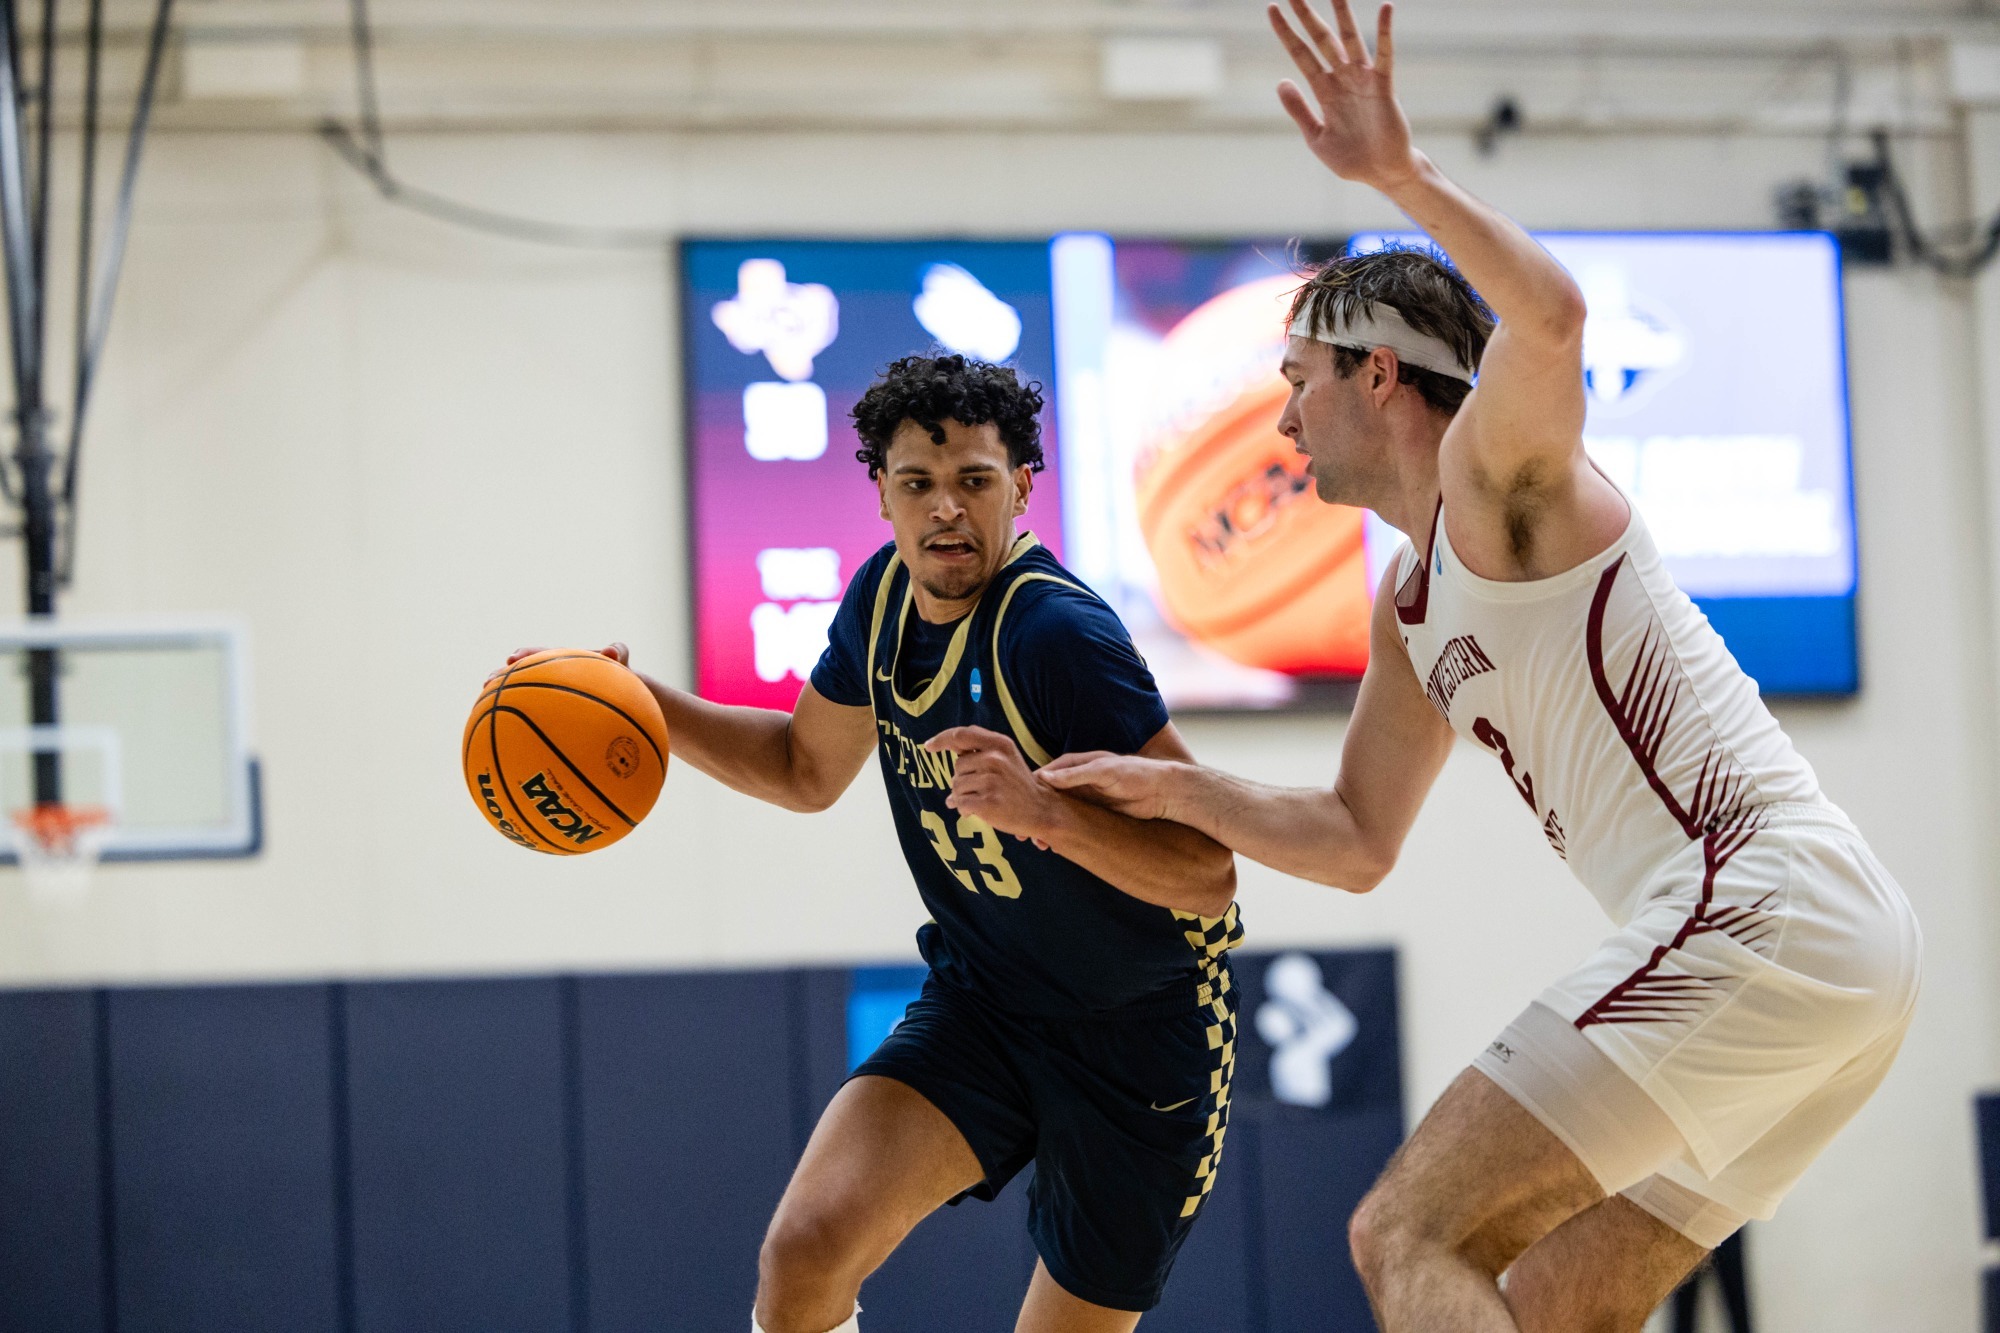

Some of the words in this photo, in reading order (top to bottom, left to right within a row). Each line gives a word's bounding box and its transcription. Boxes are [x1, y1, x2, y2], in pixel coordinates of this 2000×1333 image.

[521, 771, 604, 844] NCAA
[1472, 716, 1538, 816] 2
[920, 809, 1023, 899] 23
